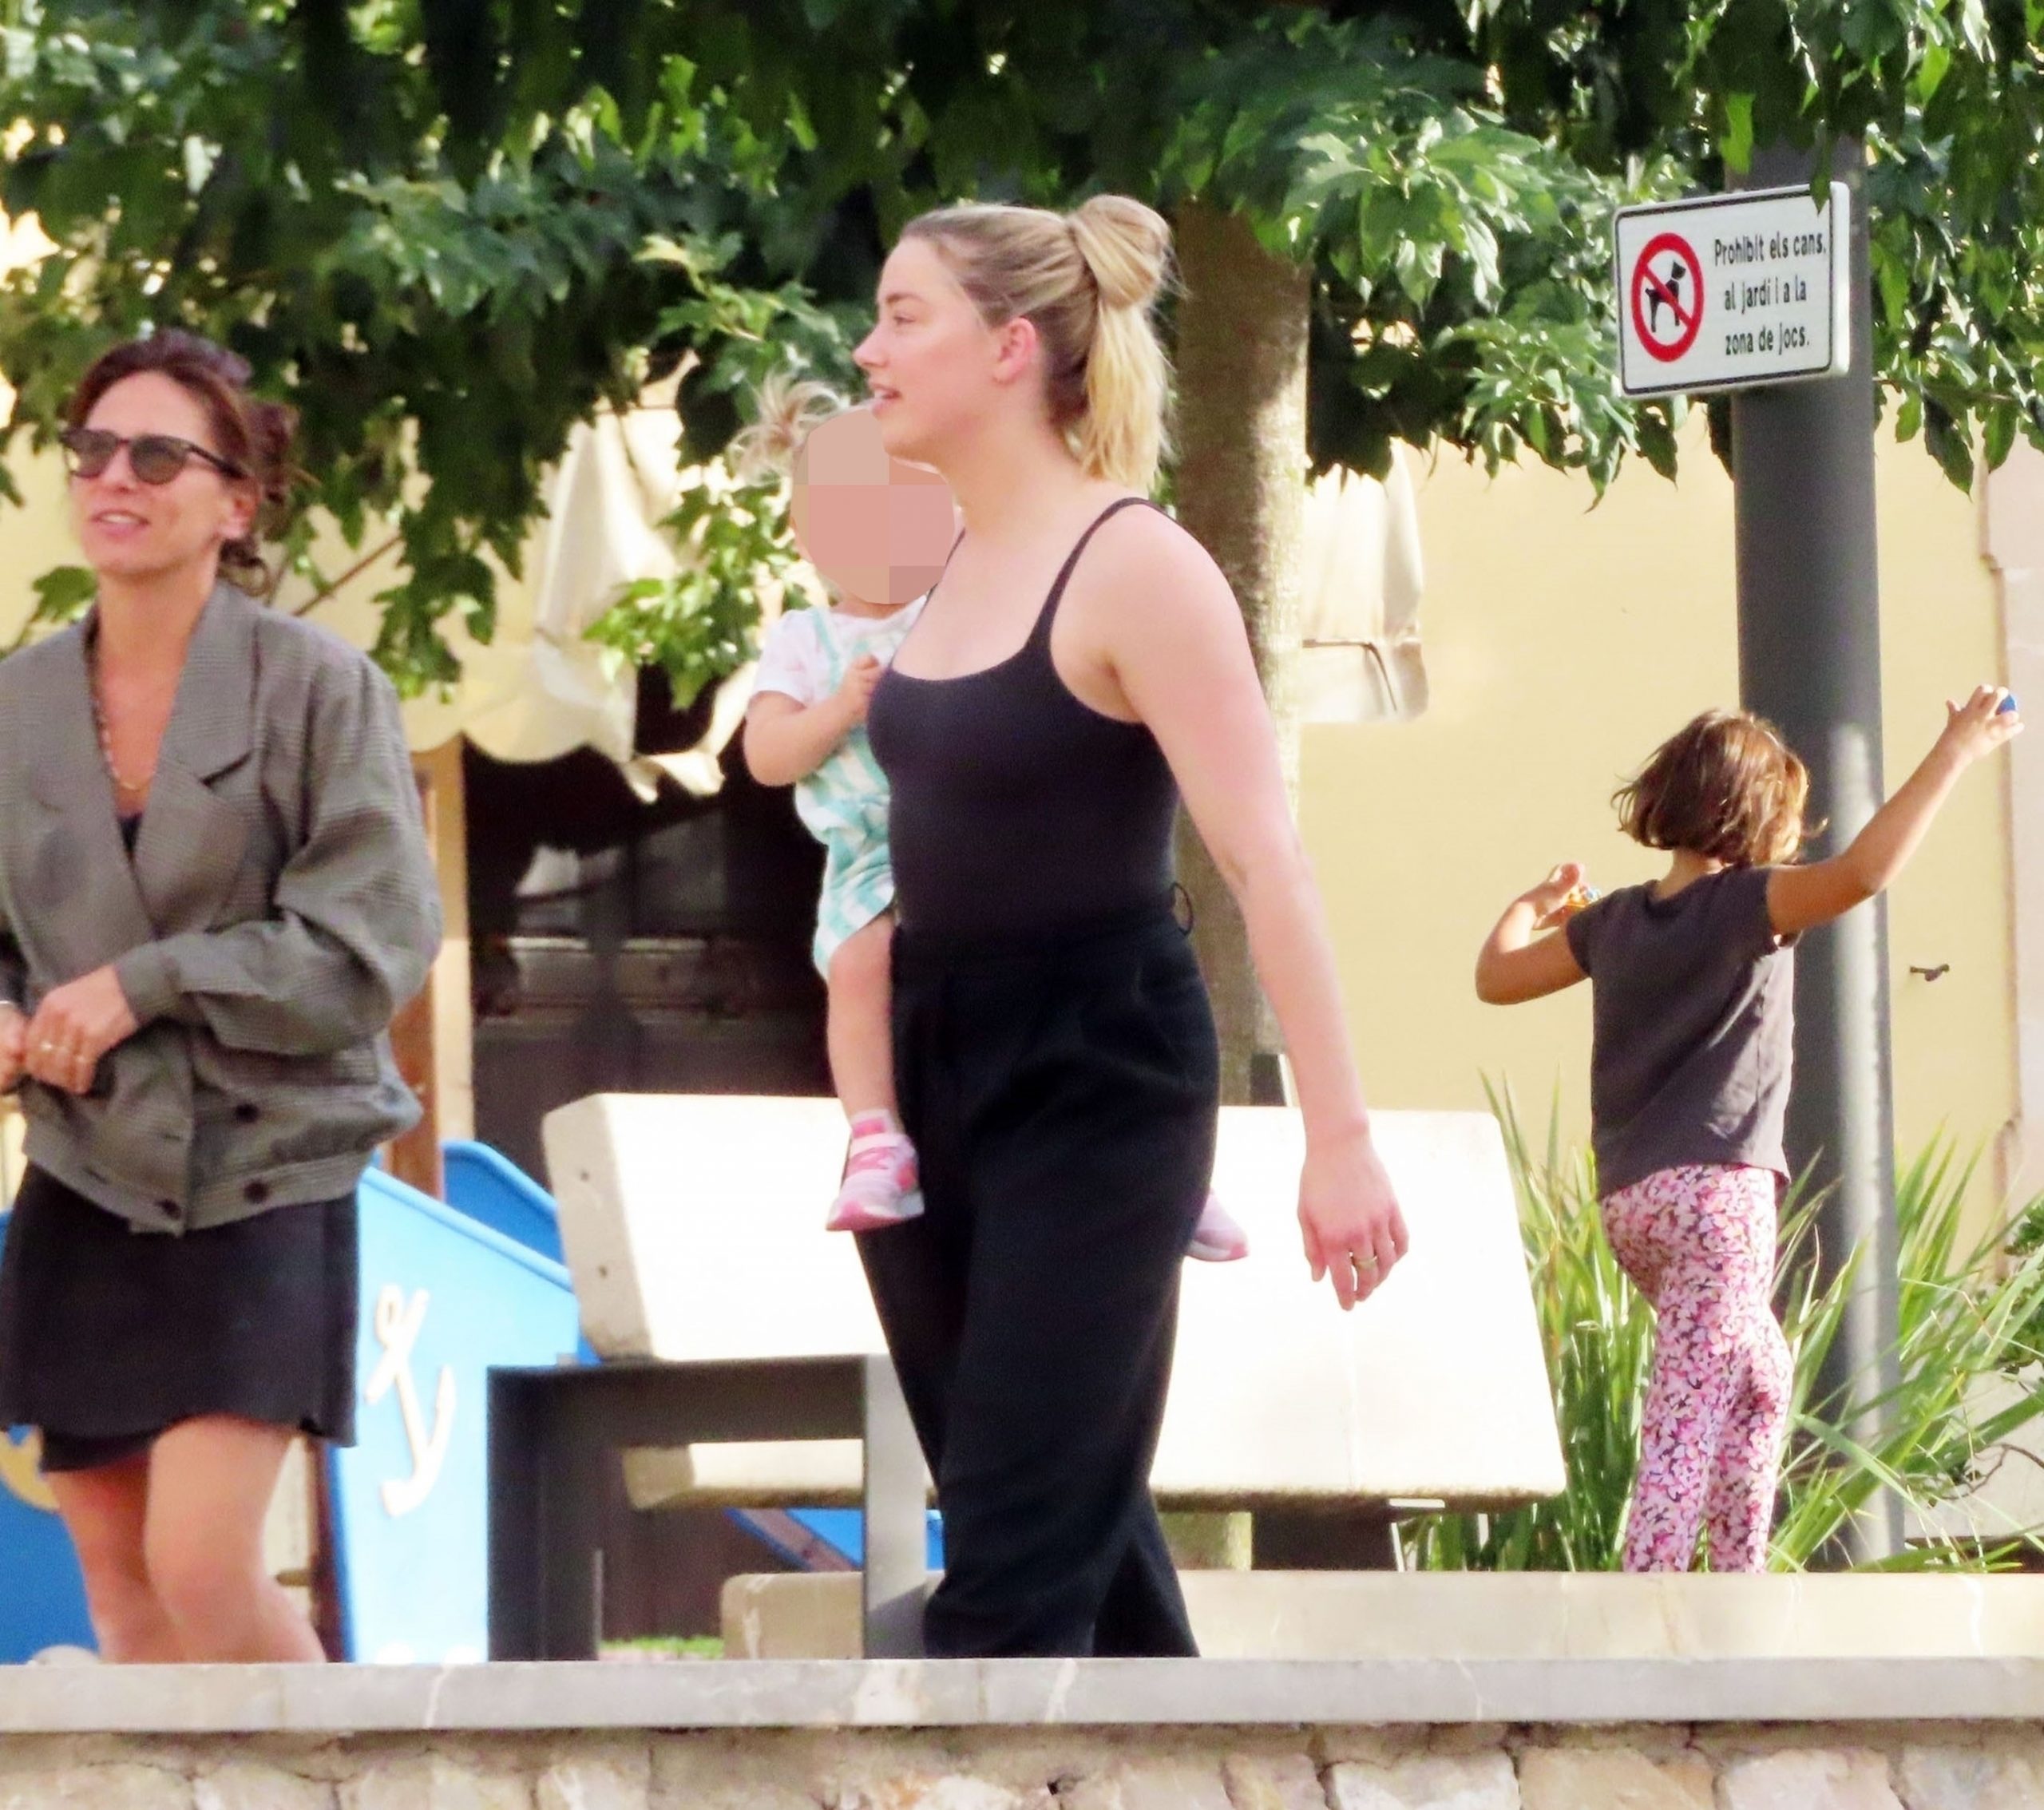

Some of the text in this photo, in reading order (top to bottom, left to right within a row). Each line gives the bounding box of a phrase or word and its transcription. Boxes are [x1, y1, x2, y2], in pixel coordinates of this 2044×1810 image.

[1714, 234, 1765, 266] Prohibit
[1769, 232, 1788, 259] els
[1725, 283, 1735, 311] al
[1784, 282, 1790, 303] a
[1796, 275, 1806, 301] la
[1725, 323, 1809, 355] zona de jocs.
